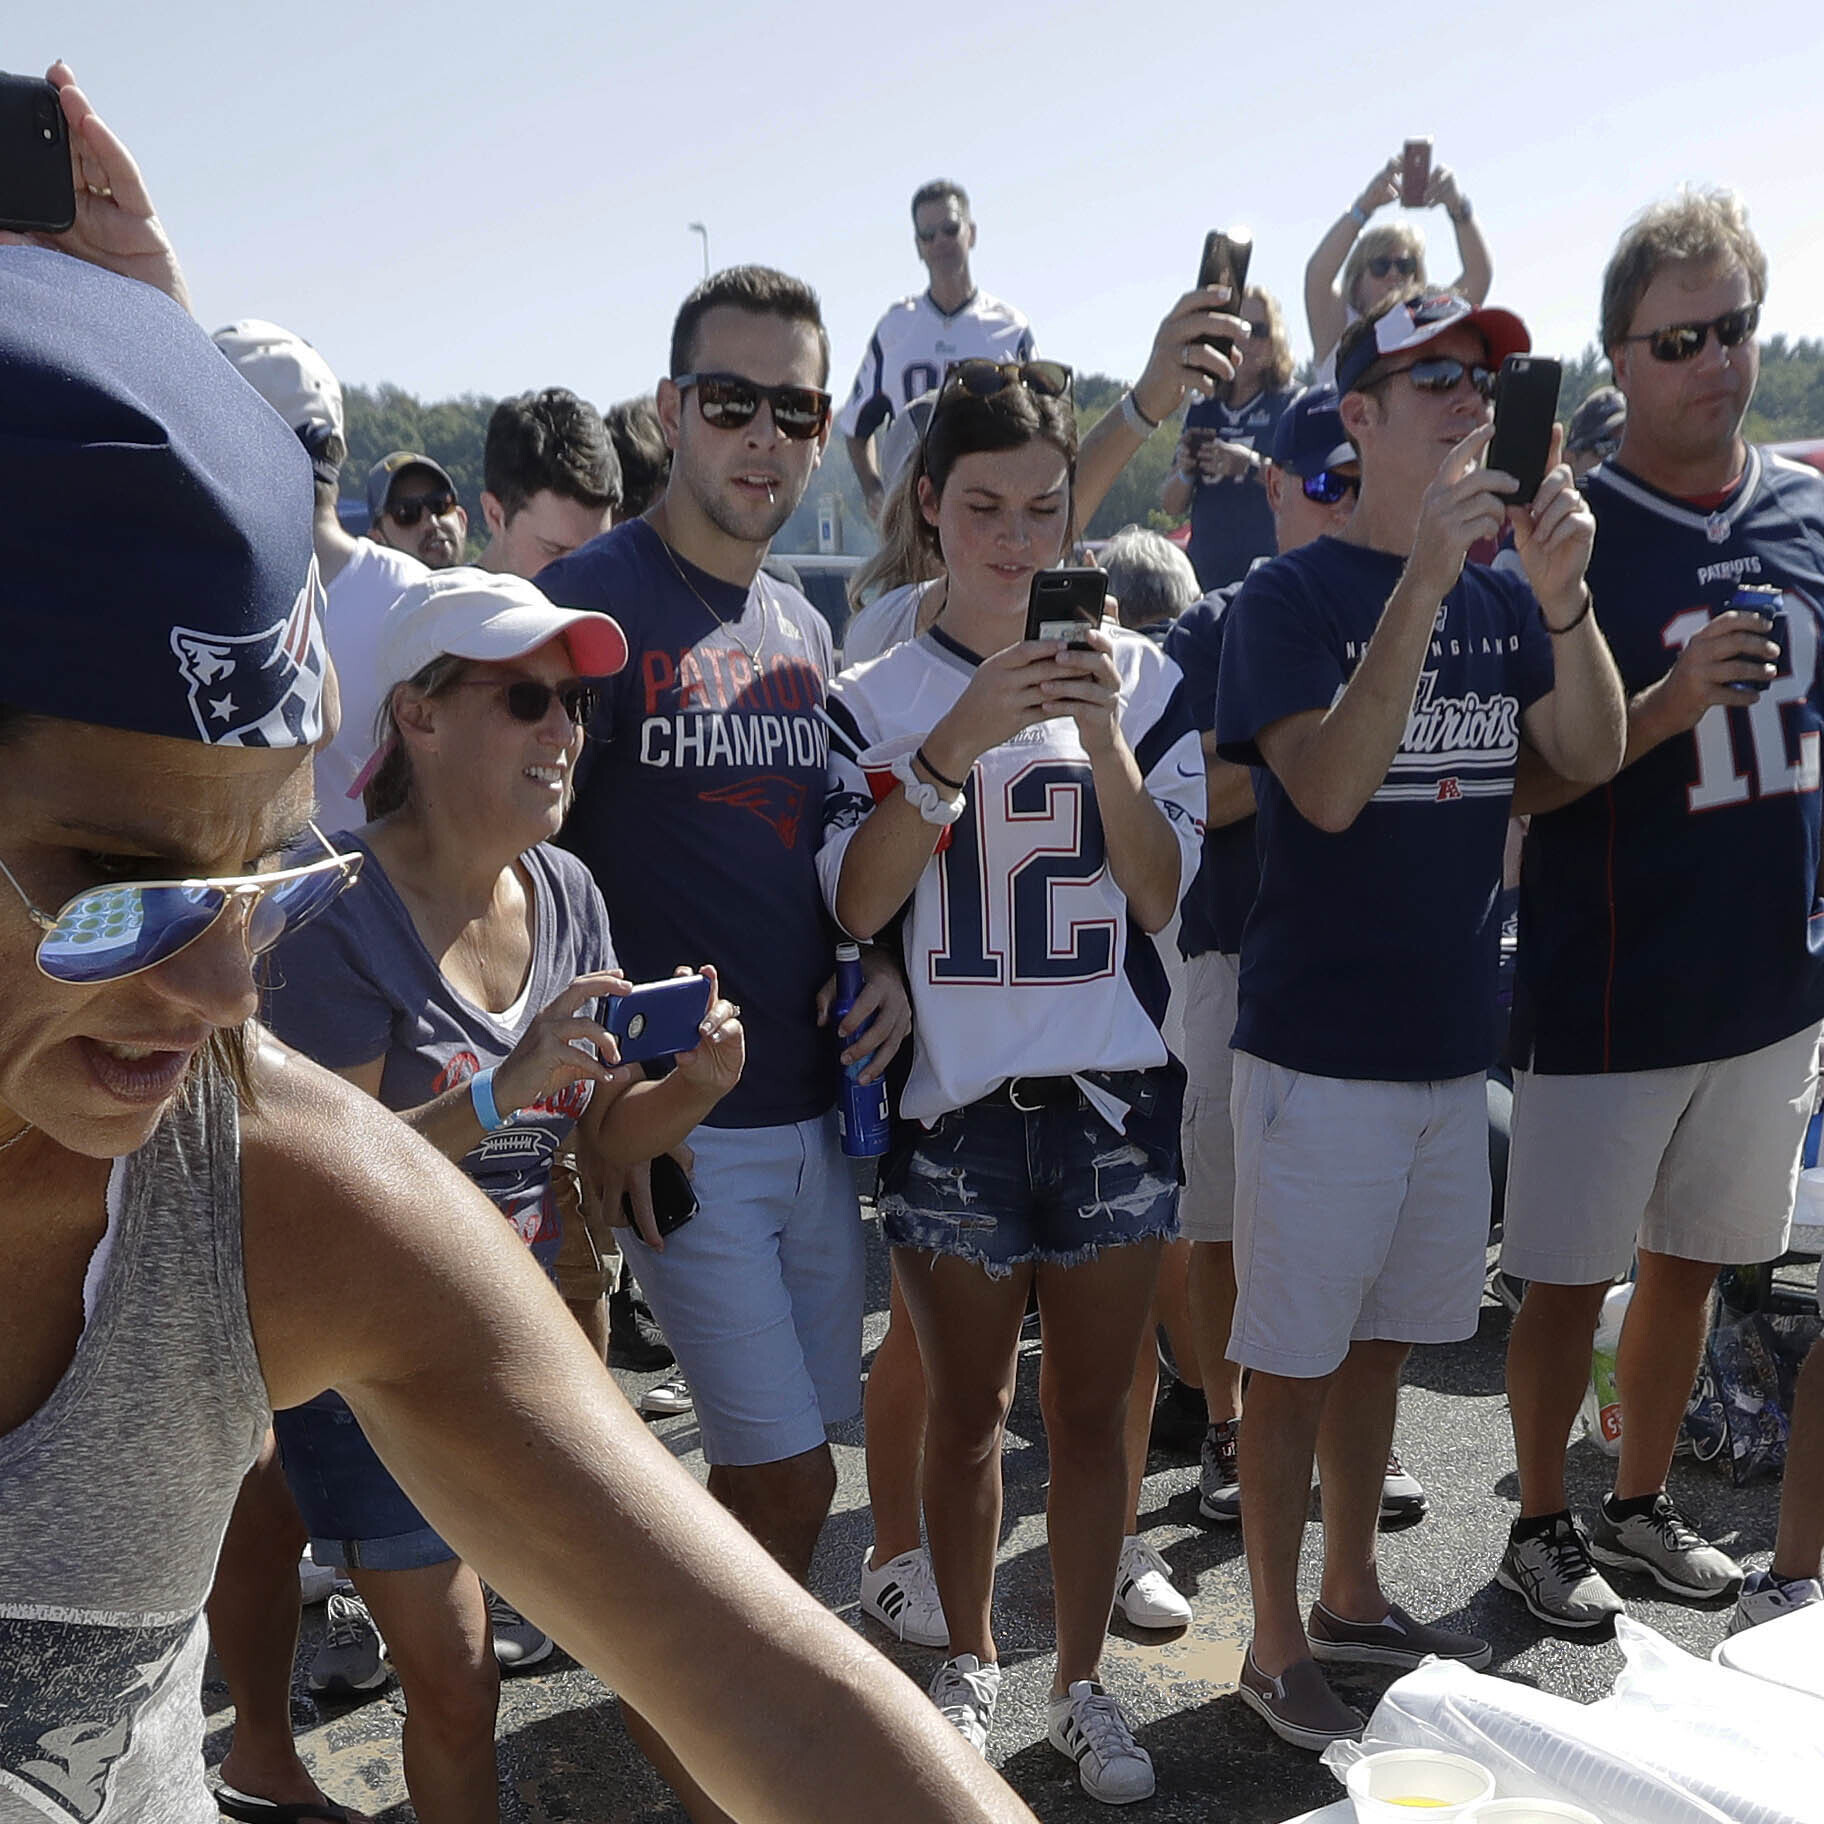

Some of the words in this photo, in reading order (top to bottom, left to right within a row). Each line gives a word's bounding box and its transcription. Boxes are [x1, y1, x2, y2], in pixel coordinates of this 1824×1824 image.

[1697, 556, 1762, 586] PATRIOTS
[1431, 634, 1520, 657] NGLAND
[642, 648, 825, 714] PATRIOT
[640, 713, 828, 769] CHAMPION
[928, 760, 1118, 986] 12
